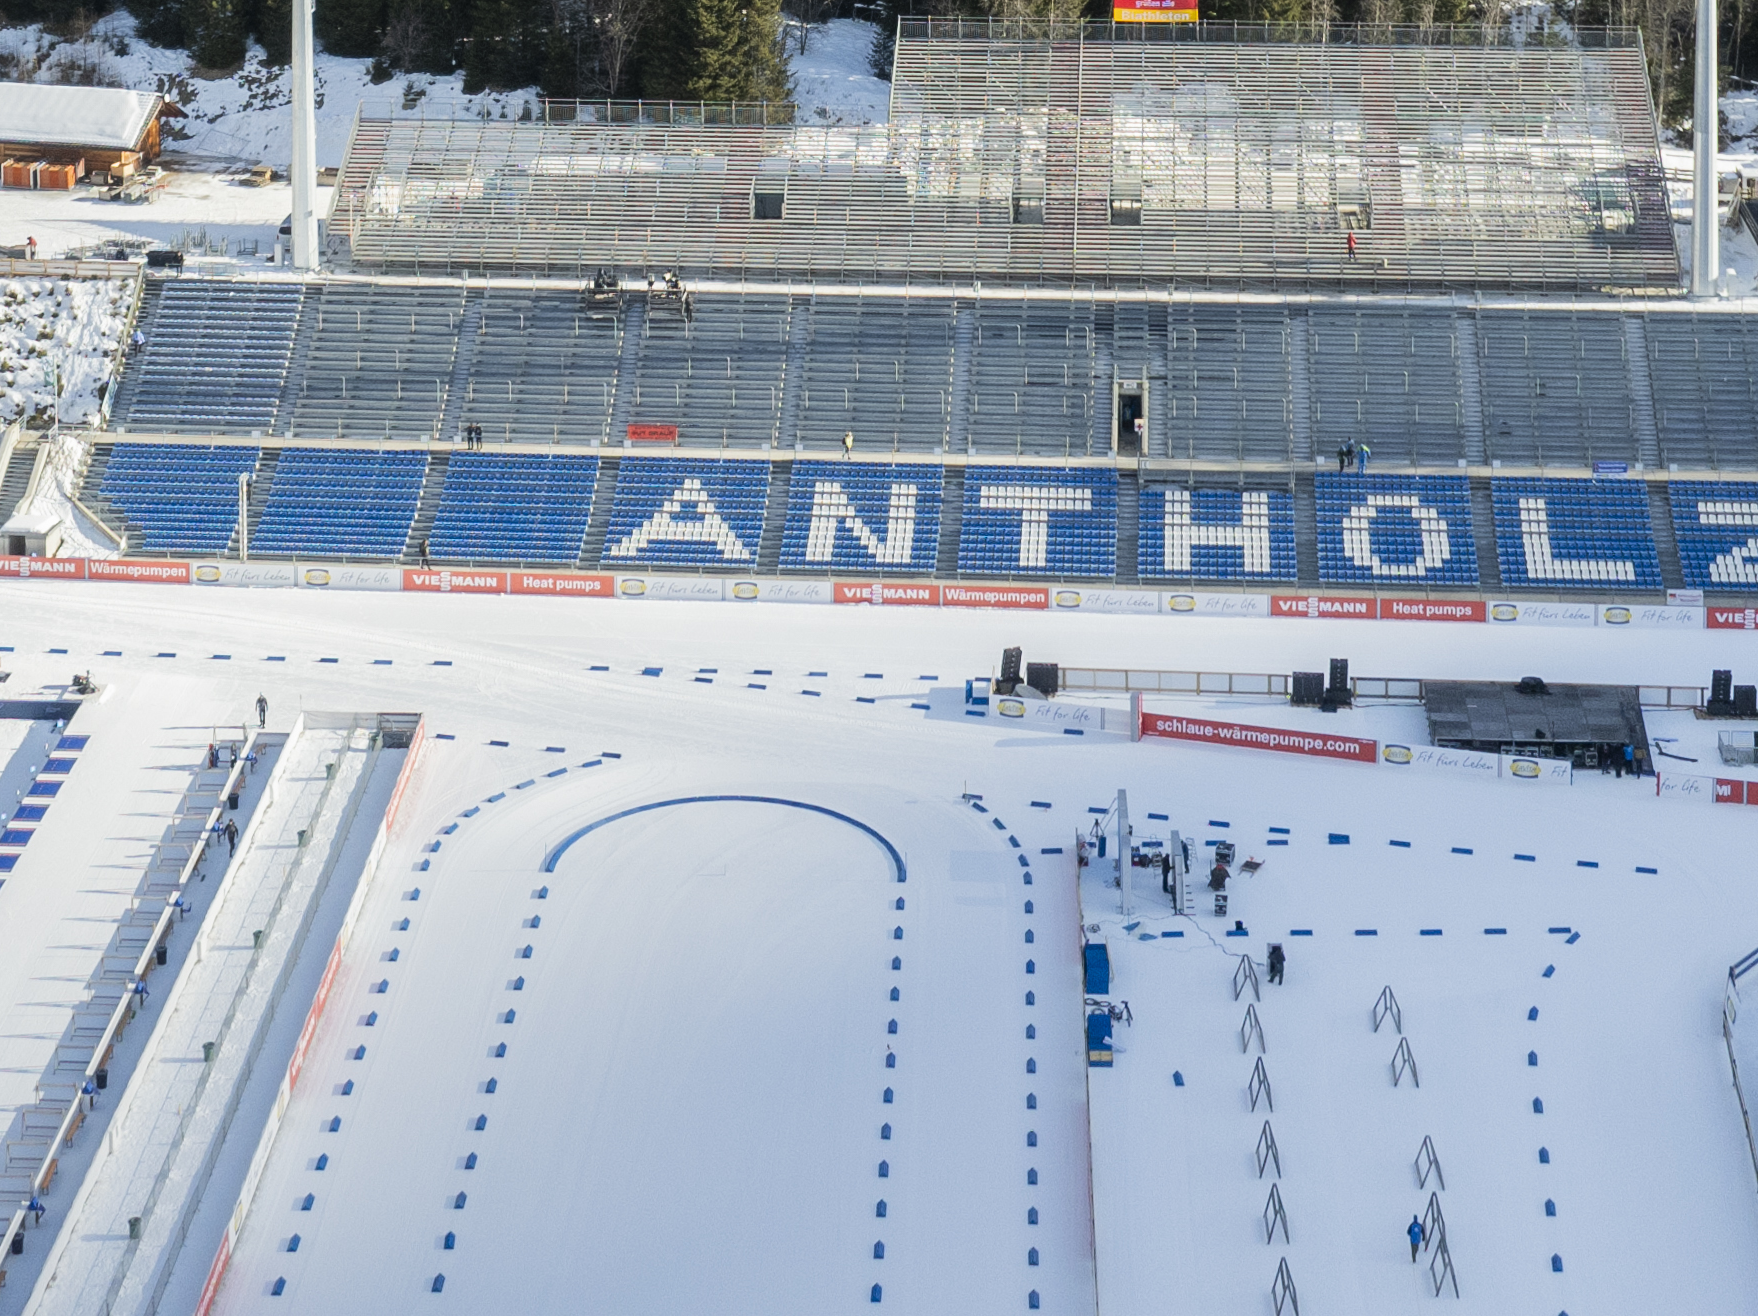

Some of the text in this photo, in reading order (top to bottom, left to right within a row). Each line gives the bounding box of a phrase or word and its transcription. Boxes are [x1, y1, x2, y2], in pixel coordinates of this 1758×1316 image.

[1121, 10, 1189, 20] Biathleten
[90, 561, 187, 578] Wärmepumpen
[412, 572, 497, 591] VIESSMANN
[523, 576, 601, 592] Heat pumps
[843, 584, 930, 604] VIESSMANN
[945, 588, 1045, 604] Wärmepumpen
[1278, 597, 1367, 617] VIESSMANN
[1393, 602, 1472, 618] Heat pumps
[1156, 719, 1360, 754] schlaue-wärmepumpe.com
